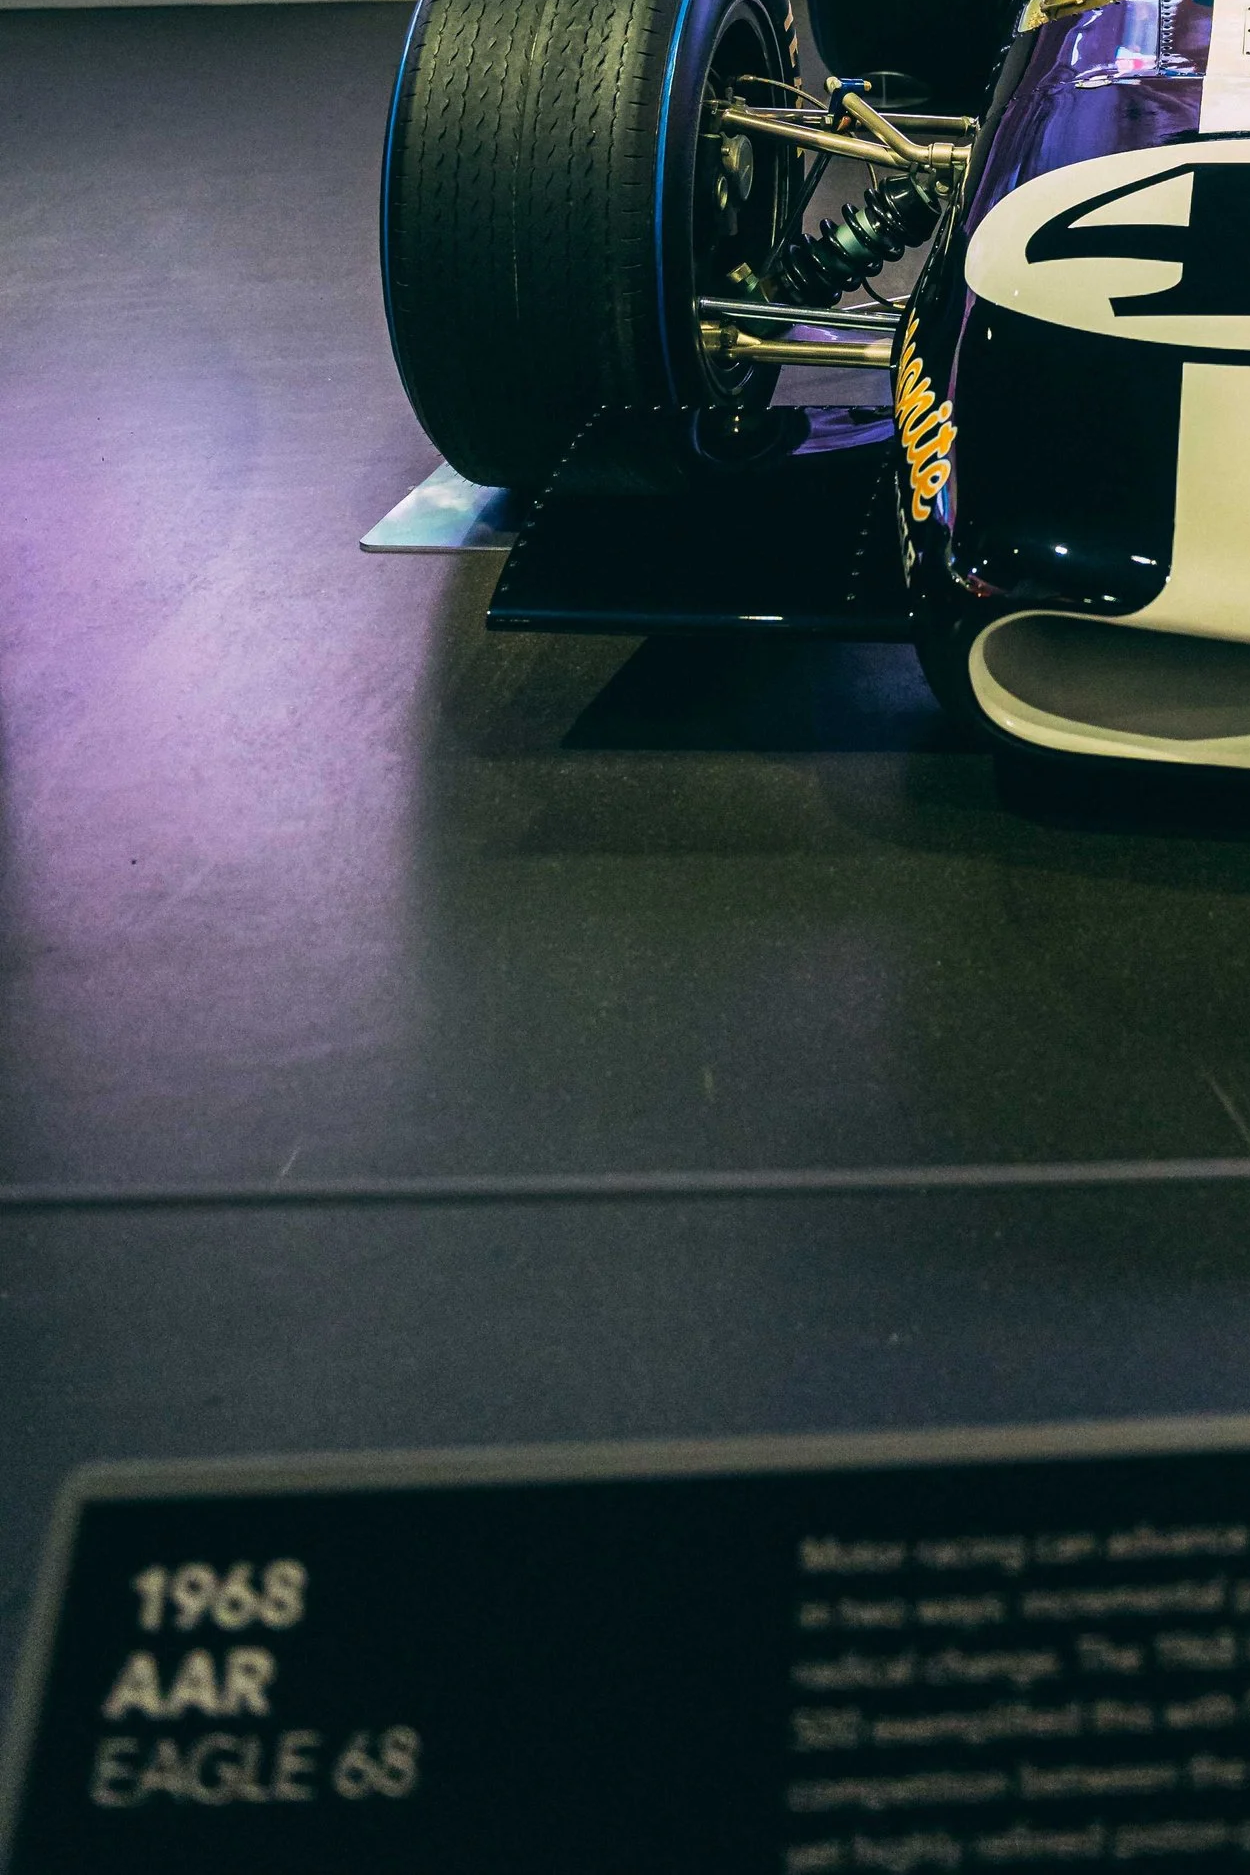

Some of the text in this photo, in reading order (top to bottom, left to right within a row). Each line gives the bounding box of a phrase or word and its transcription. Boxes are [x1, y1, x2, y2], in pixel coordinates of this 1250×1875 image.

[134, 1559, 307, 1631] 1968
[103, 1646, 276, 1720] AAR
[92, 1727, 418, 1806] EAGLE 68
